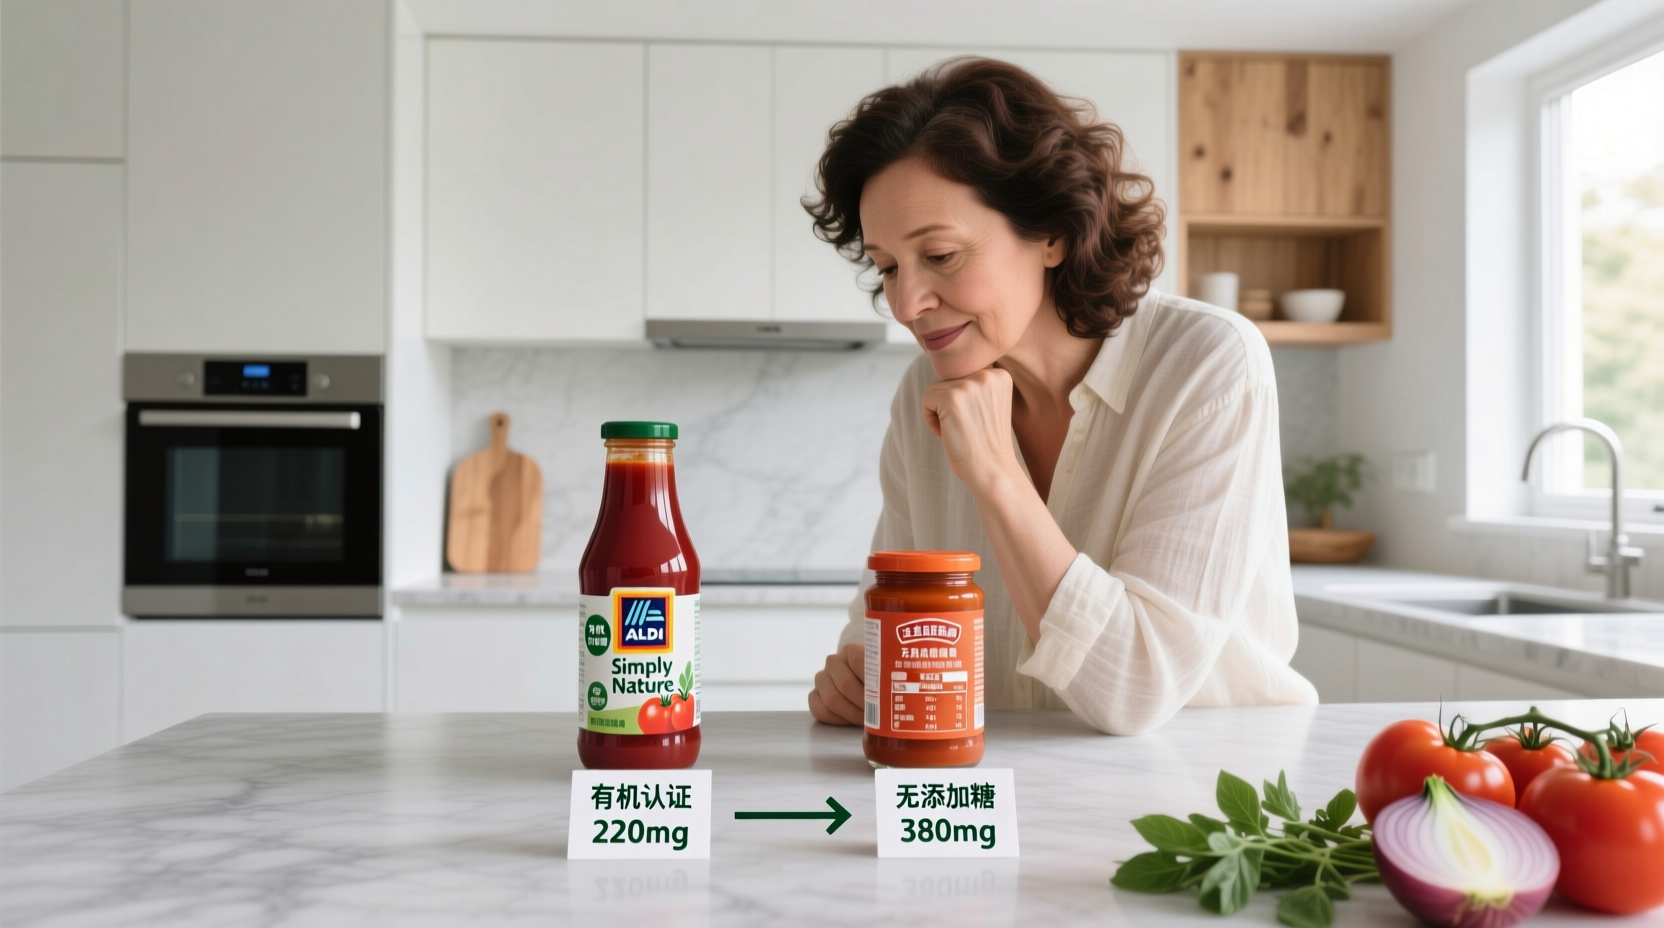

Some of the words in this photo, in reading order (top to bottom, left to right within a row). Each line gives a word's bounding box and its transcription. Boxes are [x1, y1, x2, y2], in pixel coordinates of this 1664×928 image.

[625, 628, 664, 641] ALDI
[611, 656, 673, 678] Simply
[612, 677, 674, 695] Nature
[591, 782, 692, 810] 有机认证
[896, 781, 996, 810] 无添加糖
[592, 819, 689, 851] 220mg
[900, 818, 996, 850] 380mg
